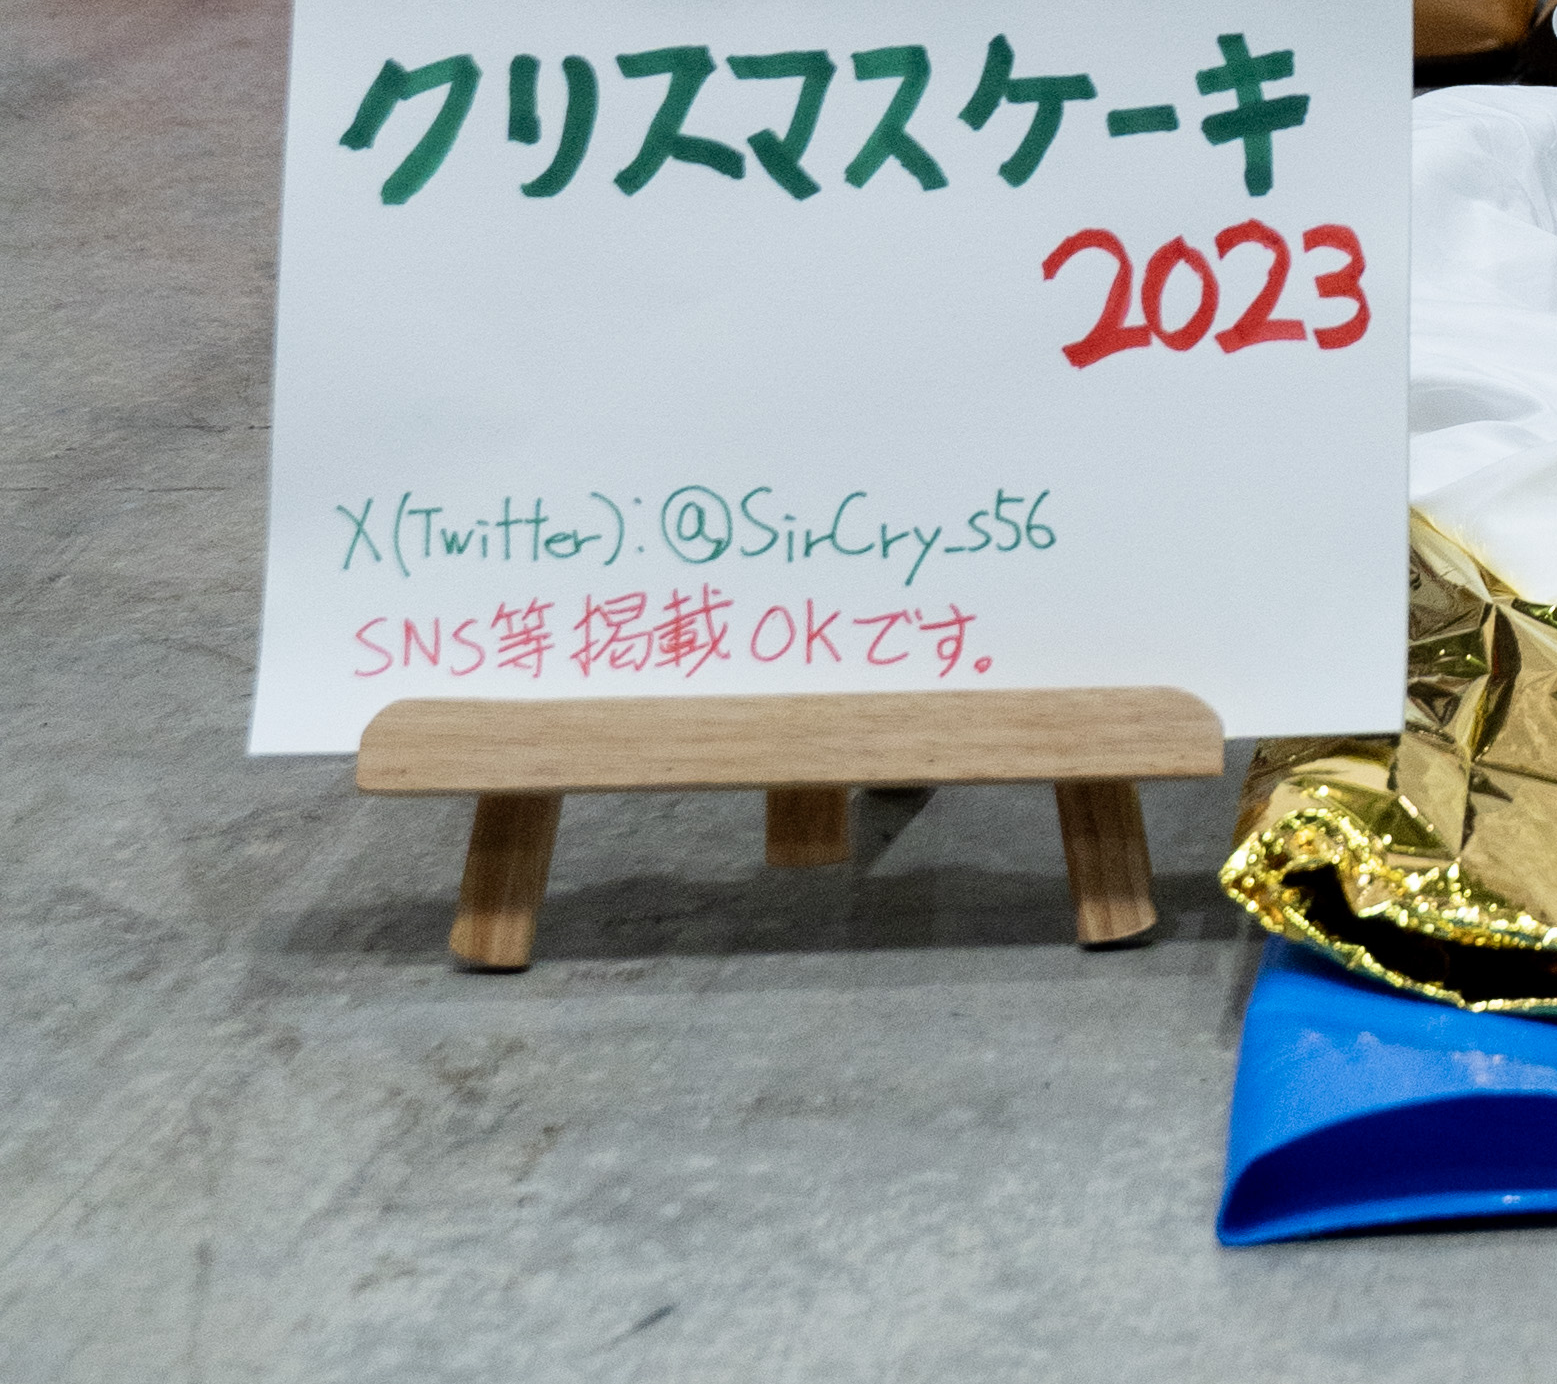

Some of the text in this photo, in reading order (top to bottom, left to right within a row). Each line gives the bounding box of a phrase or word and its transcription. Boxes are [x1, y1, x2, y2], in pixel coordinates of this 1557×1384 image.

[338, 33, 1311, 205] クリスマスケーキ
[1041, 217, 1372, 370] 2023
[353, 582, 993, 680] SNS等掲載OKです。
